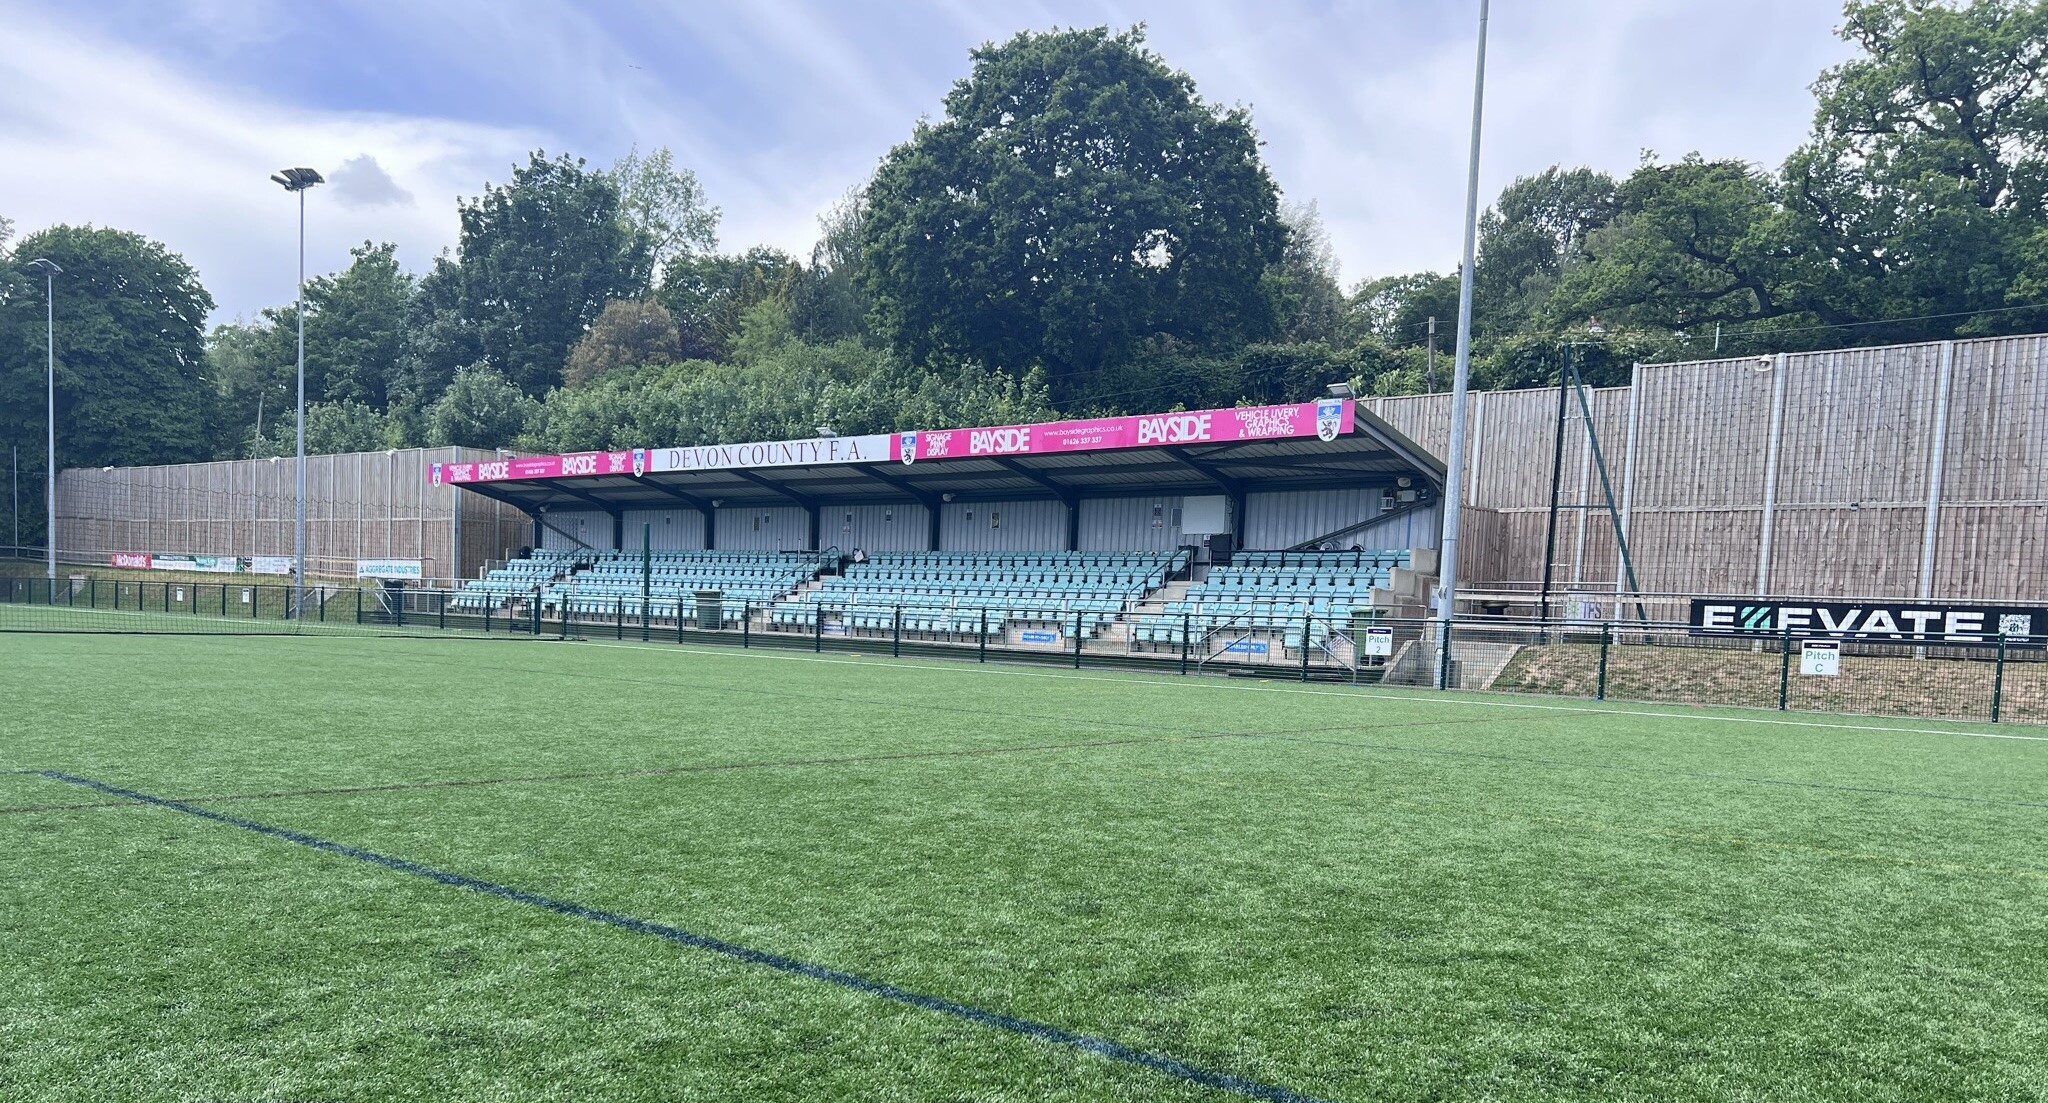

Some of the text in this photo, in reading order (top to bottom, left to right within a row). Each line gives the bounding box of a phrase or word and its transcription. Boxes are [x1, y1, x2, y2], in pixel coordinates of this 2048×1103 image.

[1234, 407, 1300, 421] VEHICLE LIVERY,
[1137, 414, 1212, 444] BAYSIDE
[1245, 416, 1290, 429] GRAPHICS
[925, 432, 952, 443] SIGNAGE
[1238, 425, 1295, 438] & WRAPPING
[969, 428, 1031, 454] BAYSIDE
[669, 440, 868, 469] DEVON COUNTY F.A.
[927, 447, 949, 457] DISPLAY
[478, 462, 509, 480] BAYSIDE
[562, 455, 597, 475] BAYSIDE
[1582, 602, 1602, 619] TFS
[1368, 635, 1390, 643] Pitch
[1805, 650, 1835, 661] Pitch
[1815, 663, 1823, 673] C
